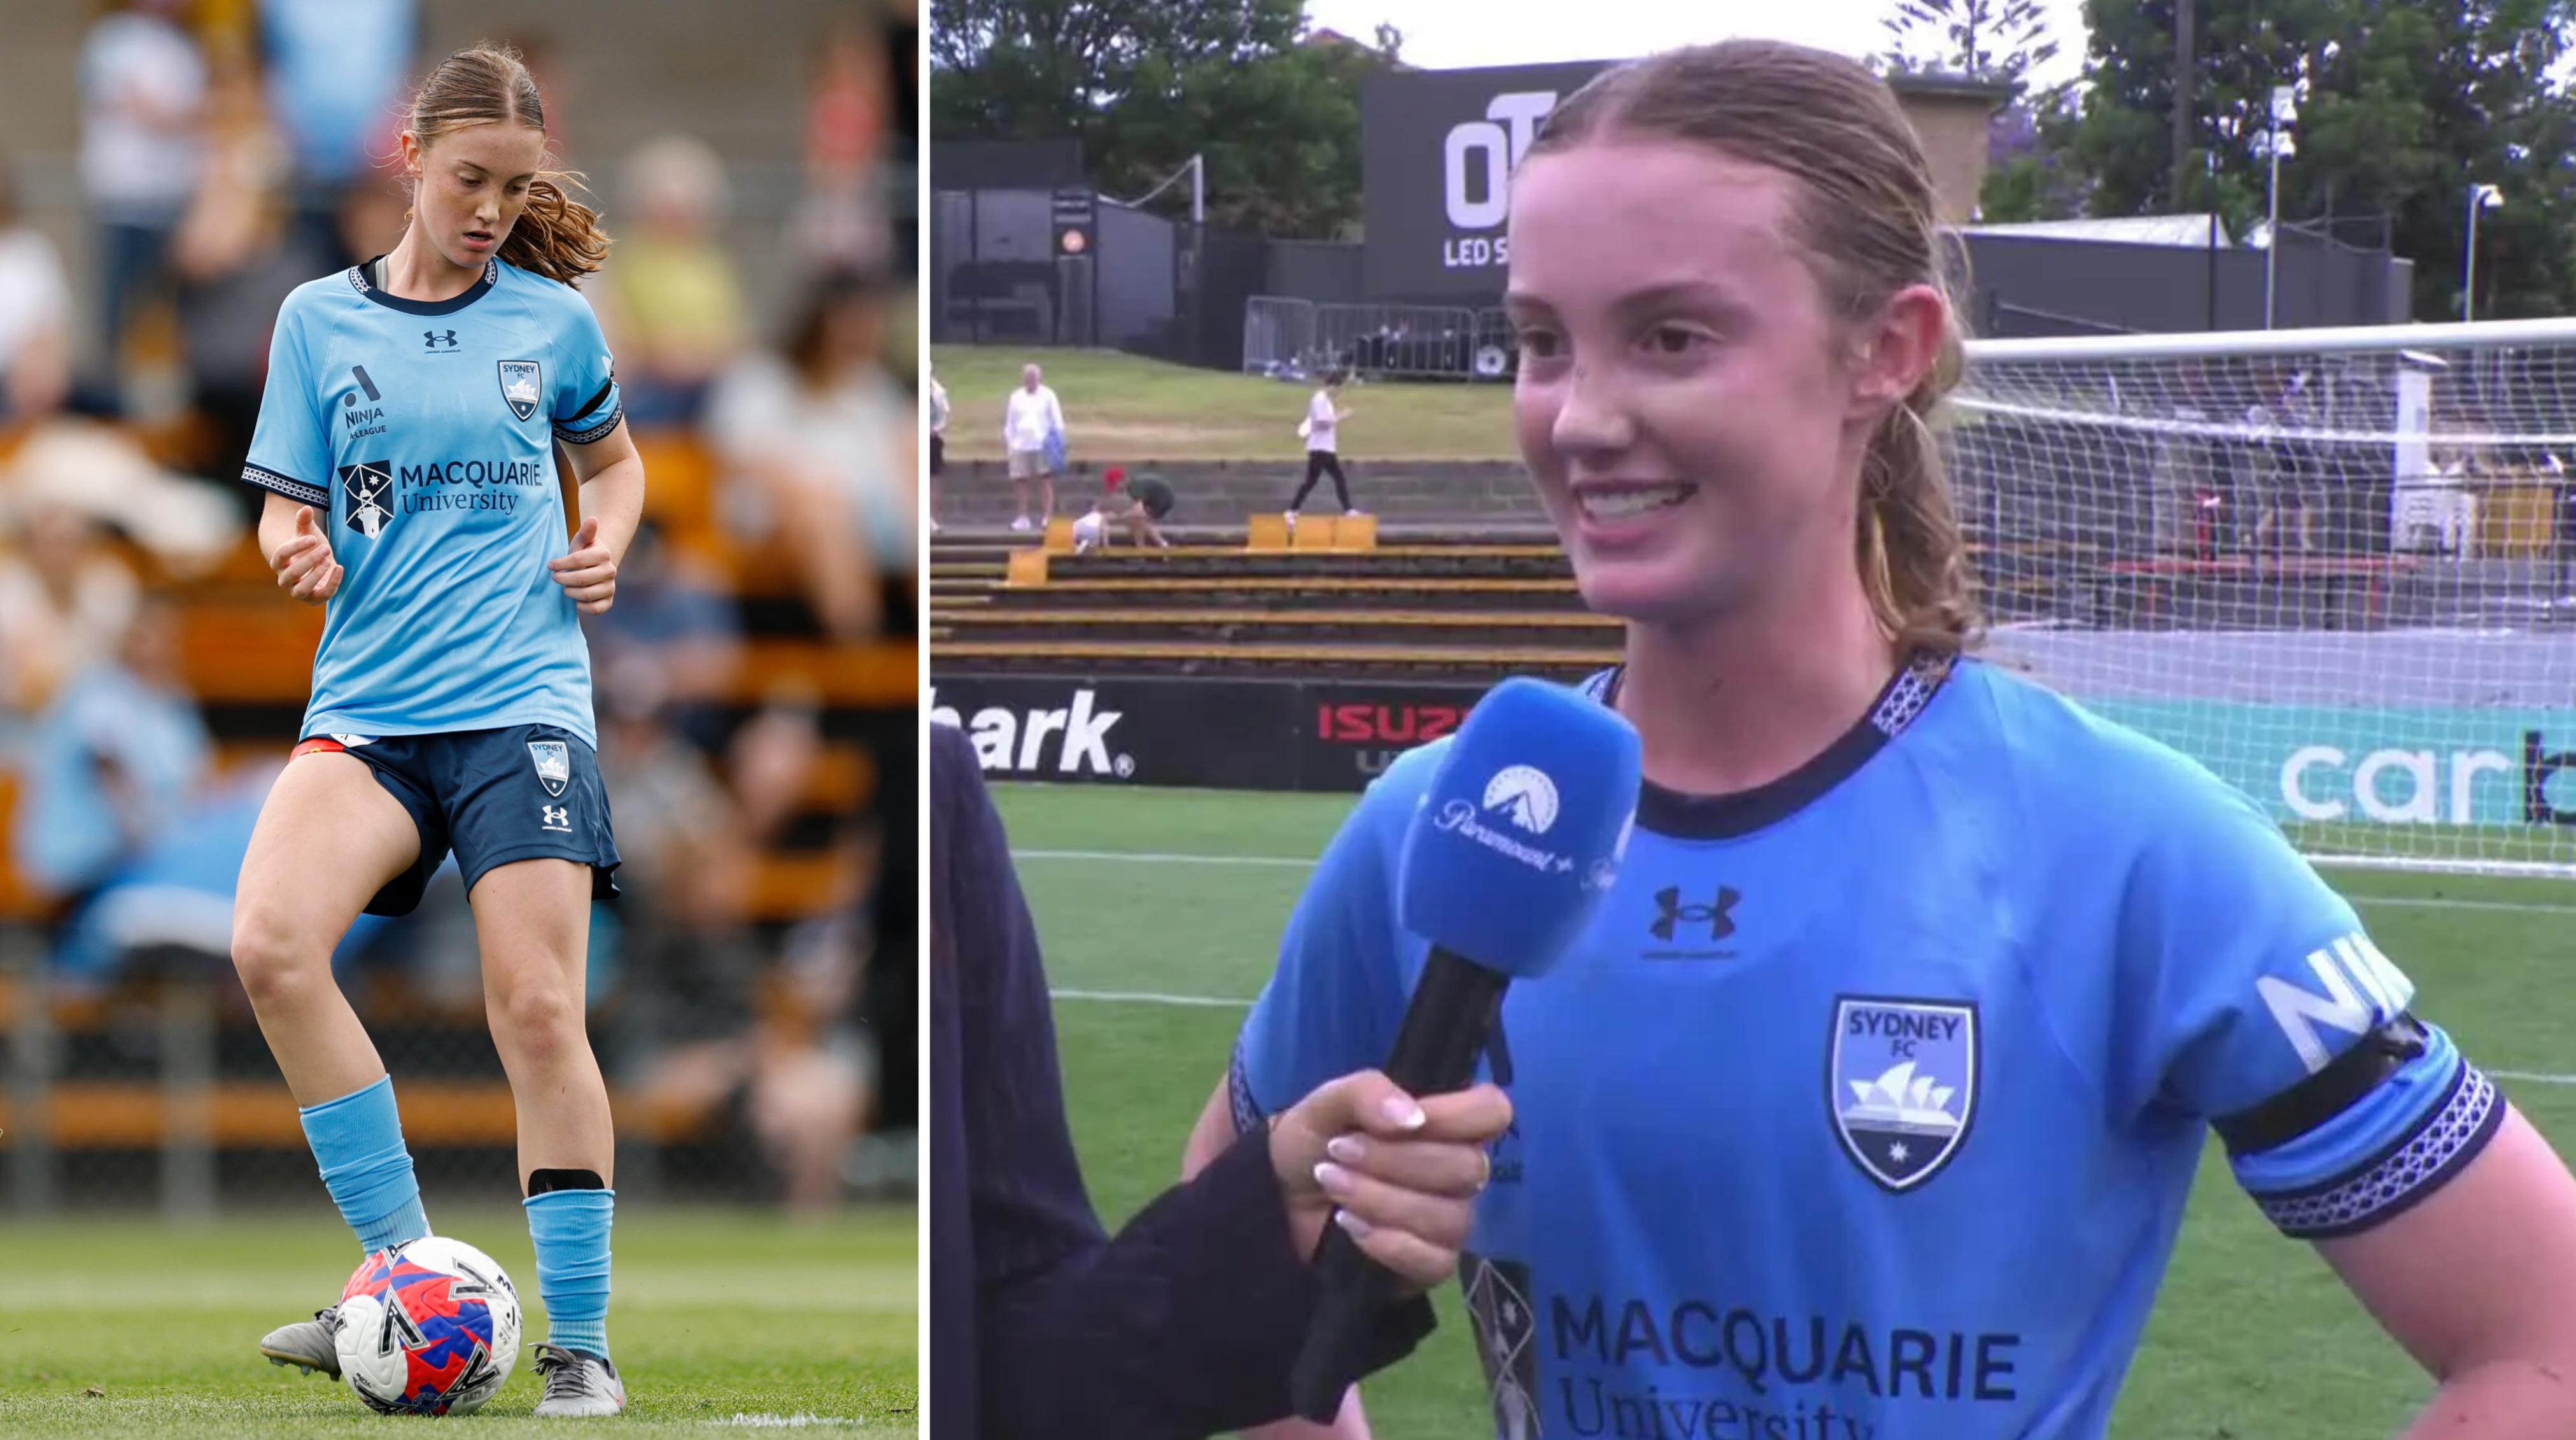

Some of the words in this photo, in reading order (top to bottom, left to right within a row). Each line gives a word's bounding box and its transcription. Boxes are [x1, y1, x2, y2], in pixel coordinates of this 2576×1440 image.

[1444, 238, 1489, 267] LED
[503, 365, 535, 374] SYDNEY
[345, 407, 385, 429] NINJA
[349, 425, 387, 441] A-LEAGUE
[400, 461, 543, 490] MACQUARIE
[401, 490, 519, 516] University
[1319, 704, 1475, 742] ISUZ
[531, 744, 563, 752] SYDNEY
[1848, 1010, 1959, 1041] SYDNEY
[1890, 1039, 1917, 1058] FC
[1551, 1295, 2022, 1401] MACQUARIE
